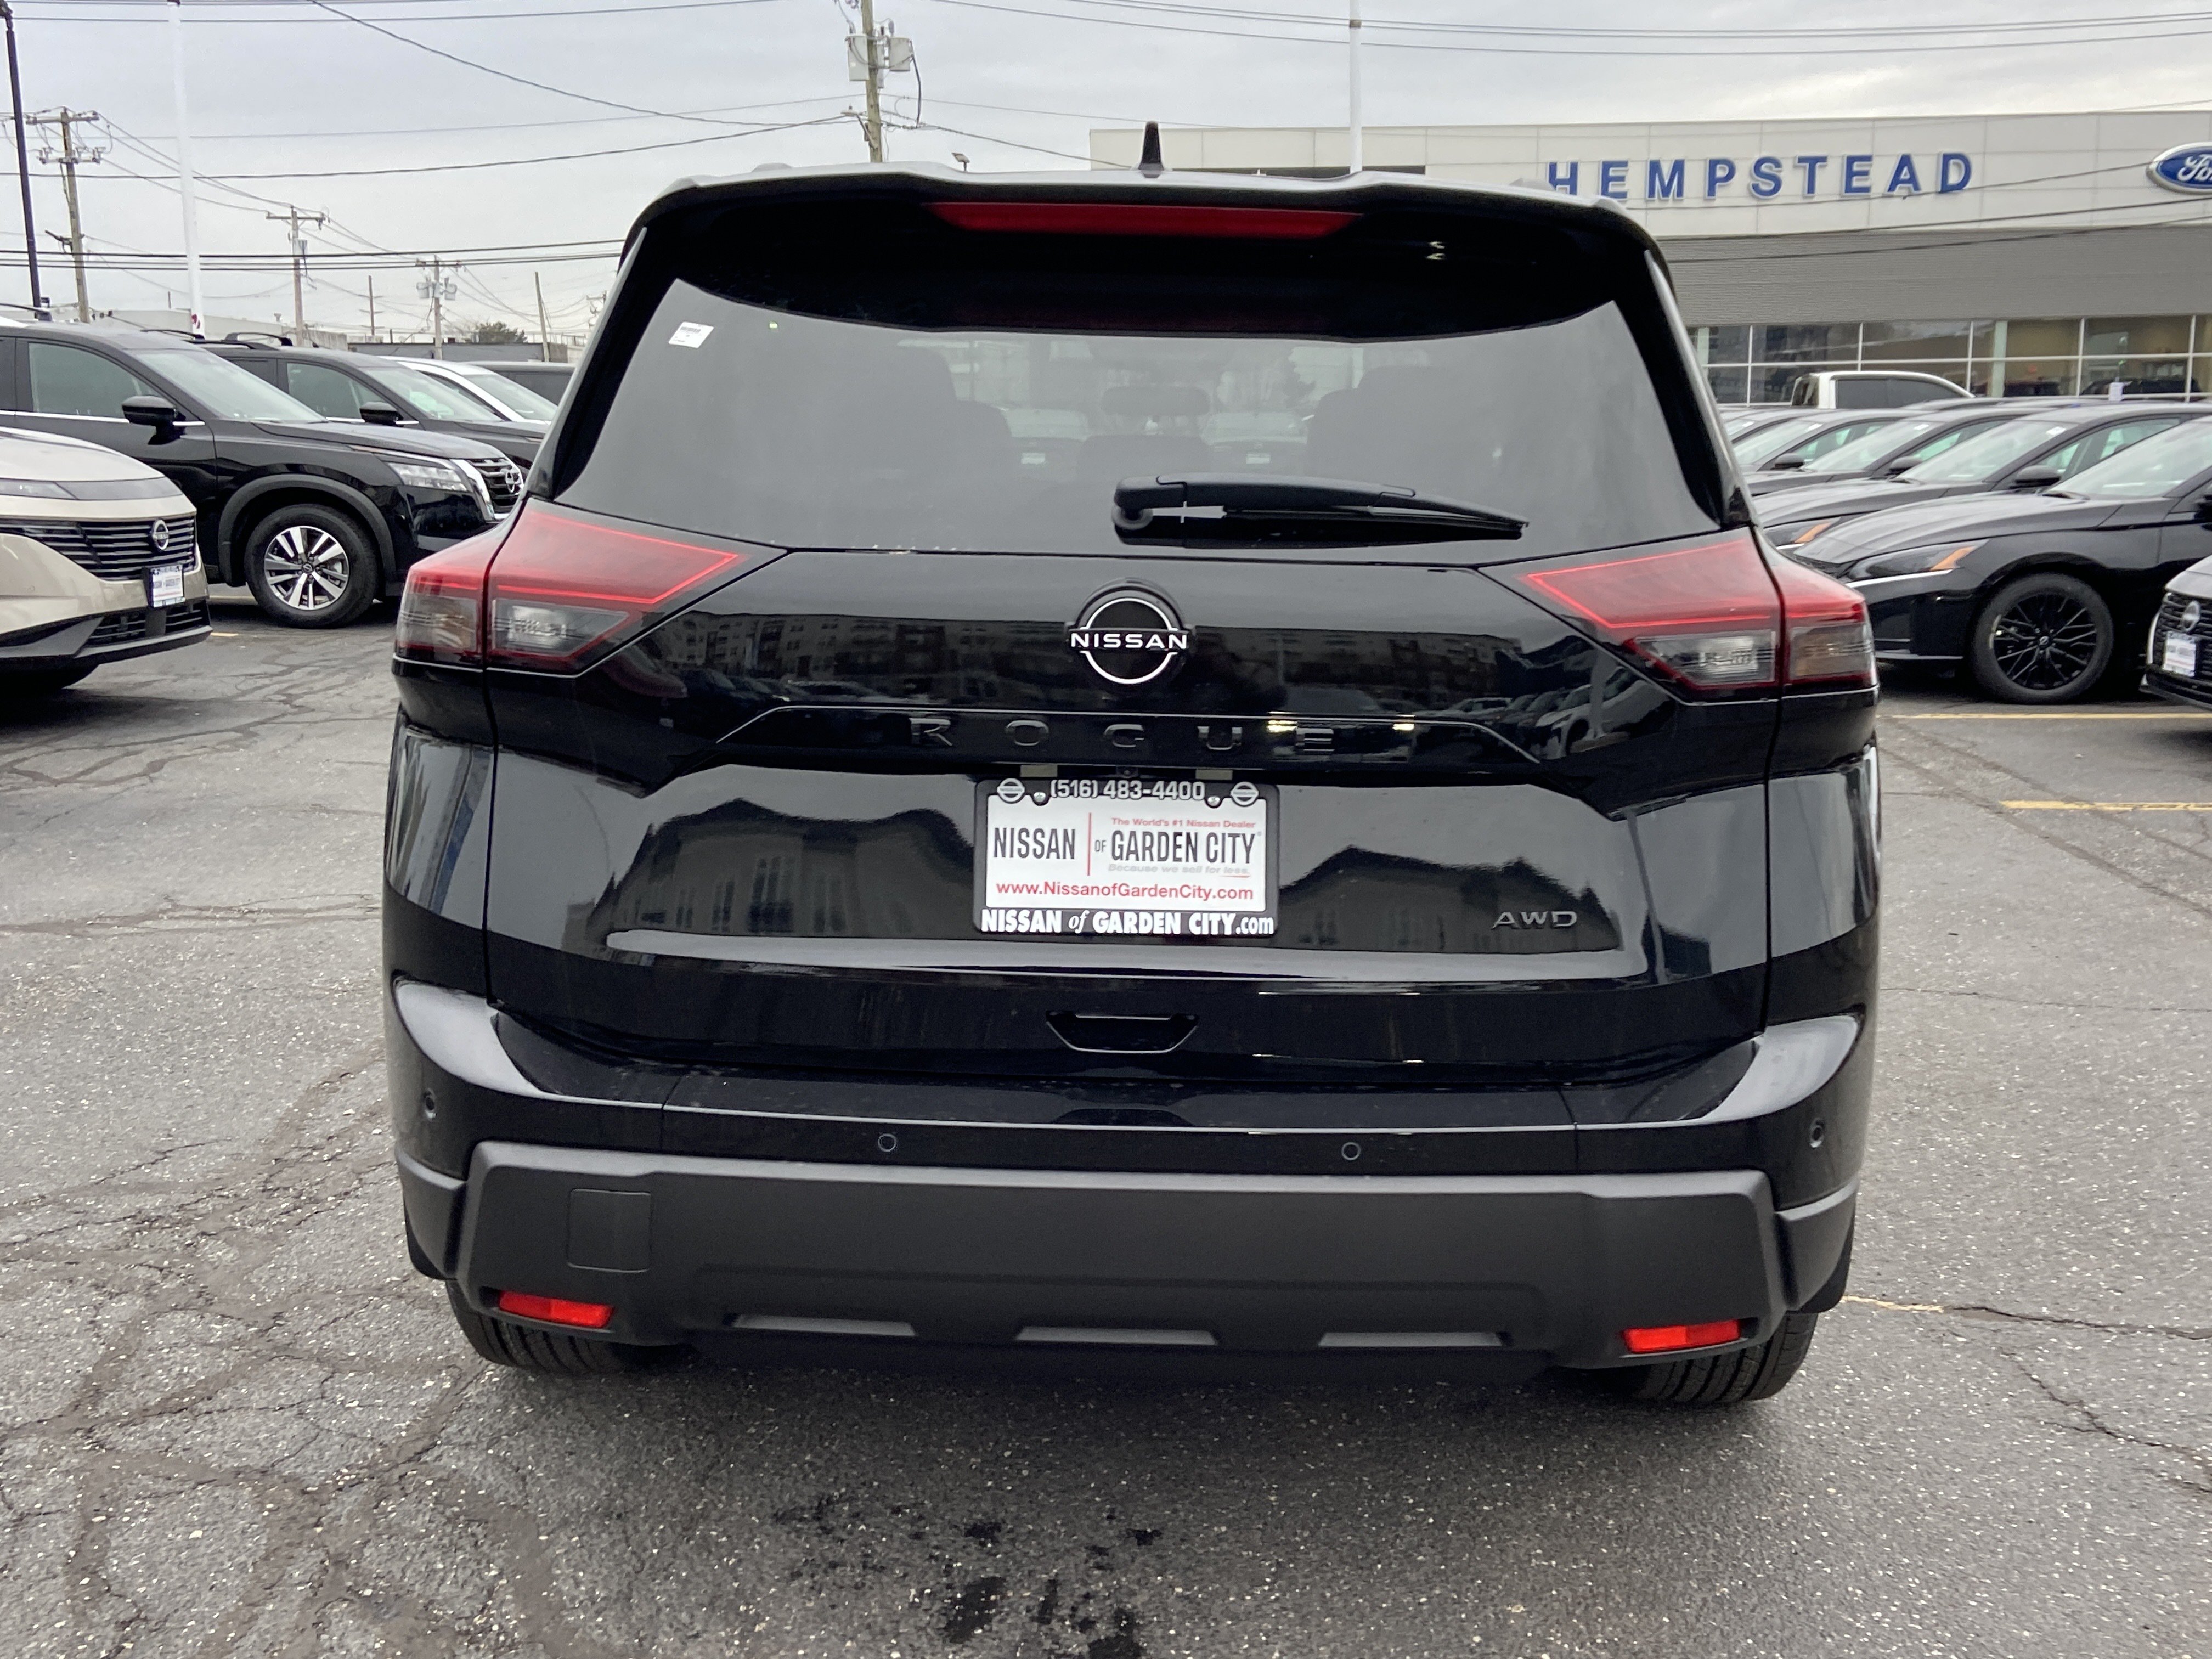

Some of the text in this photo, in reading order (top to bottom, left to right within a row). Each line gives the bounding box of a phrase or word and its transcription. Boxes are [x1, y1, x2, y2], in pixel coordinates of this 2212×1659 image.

[1547, 152, 1974, 200] HEMPSTEAD
[2177, 154, 2212, 182] Fo
[1070, 633, 1187, 650] NISSAN
[909, 717, 1335, 753] ROGUE
[1050, 779, 1205, 801] (516) 483-4400
[1111, 817, 1130, 826] The
[1132, 818, 1170, 827] World's
[1223, 820, 1256, 828] Dealer
[993, 827, 1255, 864] NISSAN OF GARDEN CITY
[1108, 863, 1158, 872] Because
[1182, 865, 1202, 873] sell
[1205, 865, 1221, 873] for
[996, 881, 1254, 901] www.NissanofGardenCity.com
[981, 909, 1274, 935] NISSAN of GARDEN CITY.com
[1490, 911, 1578, 930] AWD
